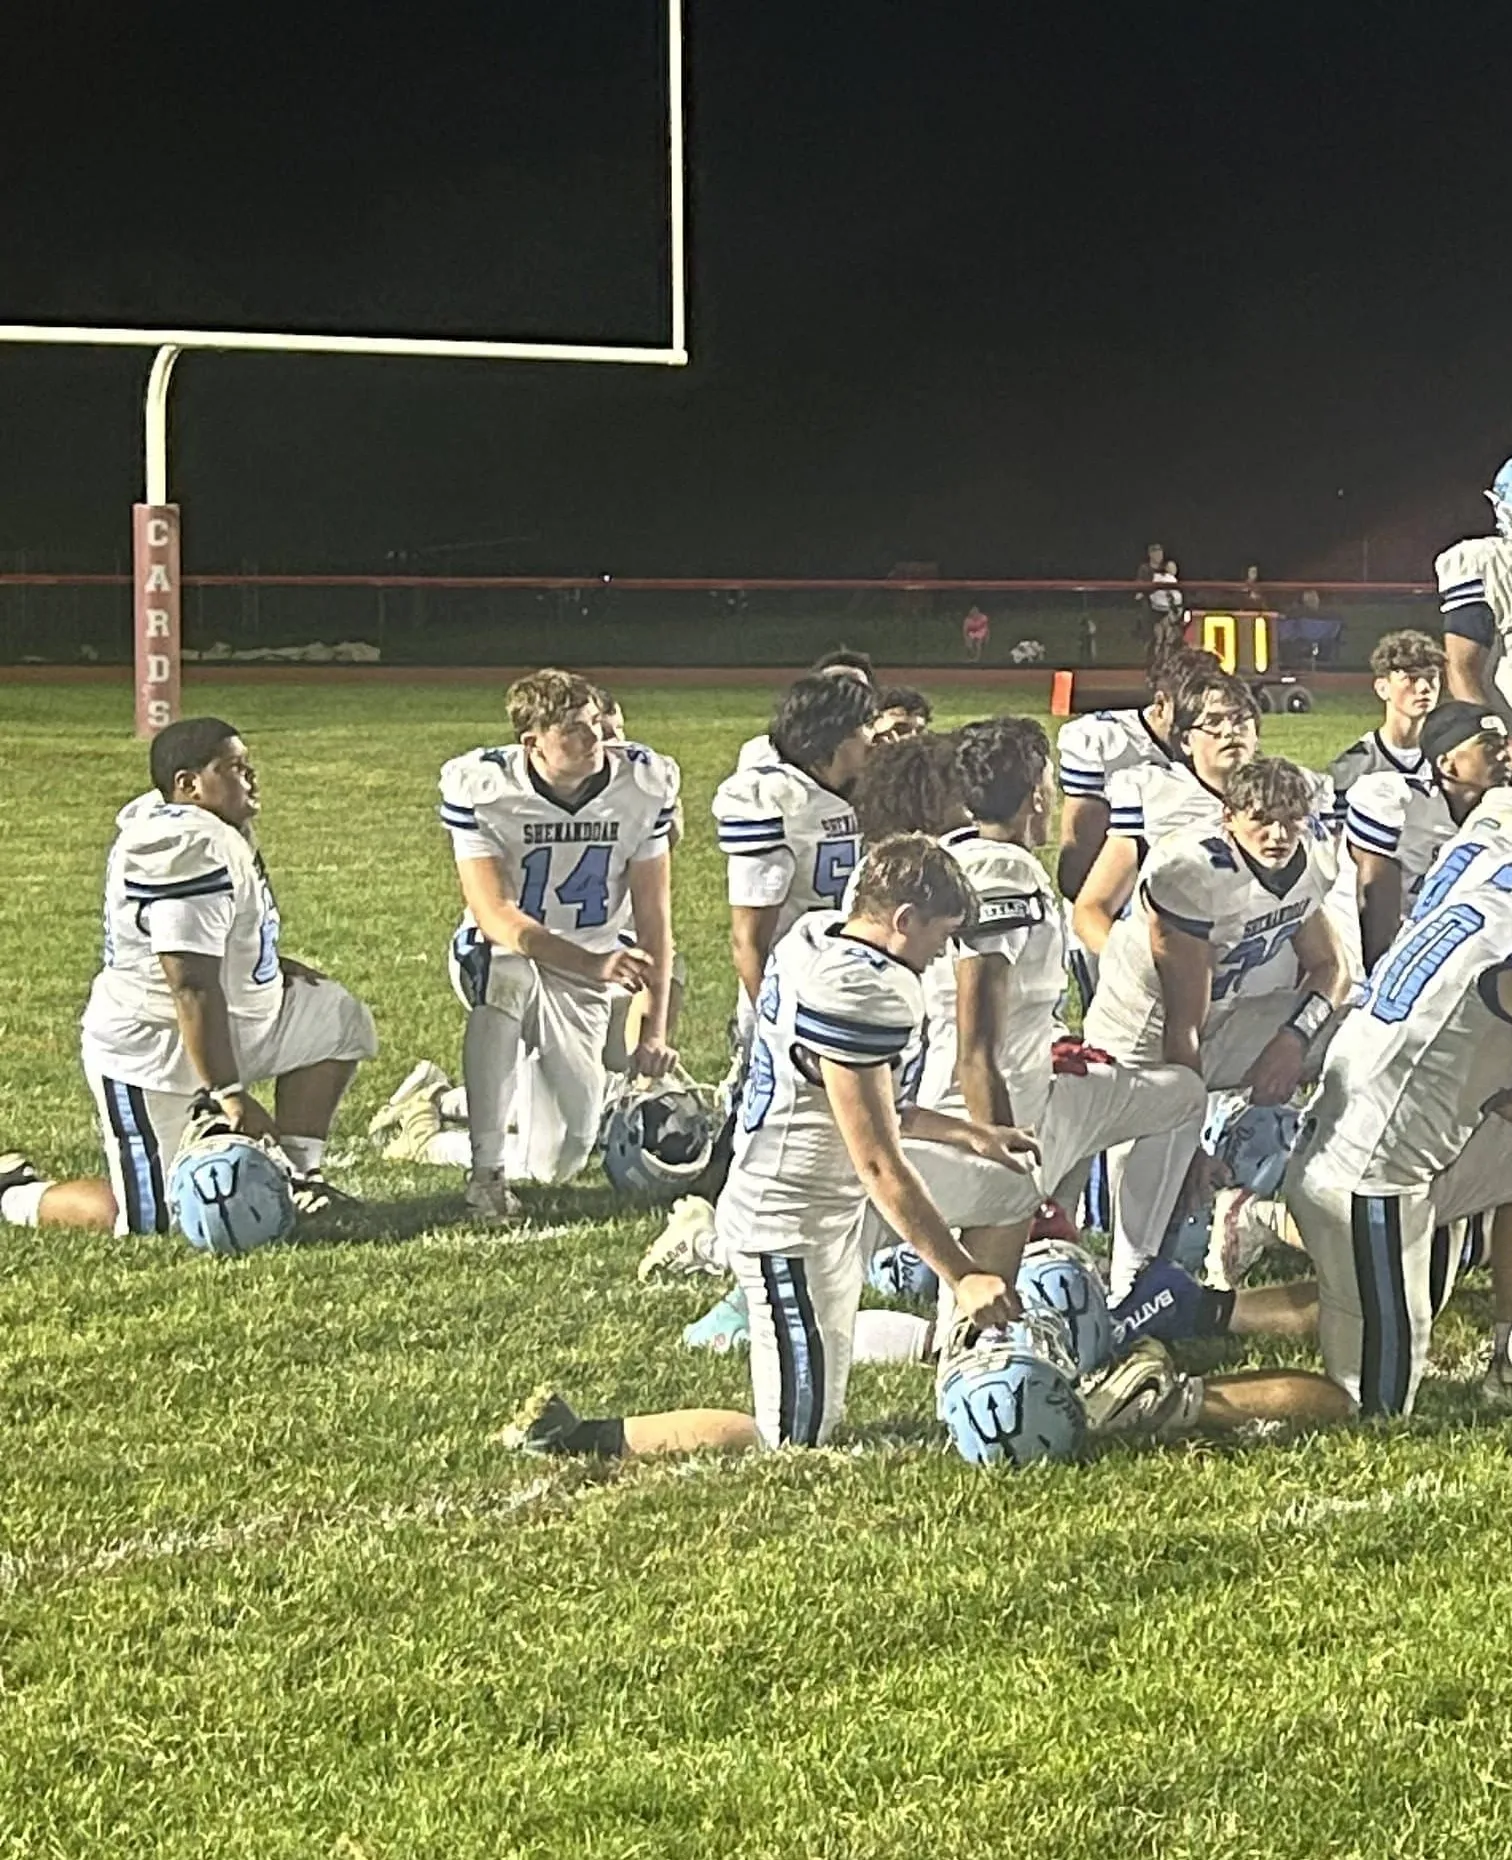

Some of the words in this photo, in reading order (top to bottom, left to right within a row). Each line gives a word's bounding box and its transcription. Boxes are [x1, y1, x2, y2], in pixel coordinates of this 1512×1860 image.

[143, 518, 171, 729] CARDS
[523, 821, 620, 844] SHENANDOAH
[519, 845, 614, 929] 14
